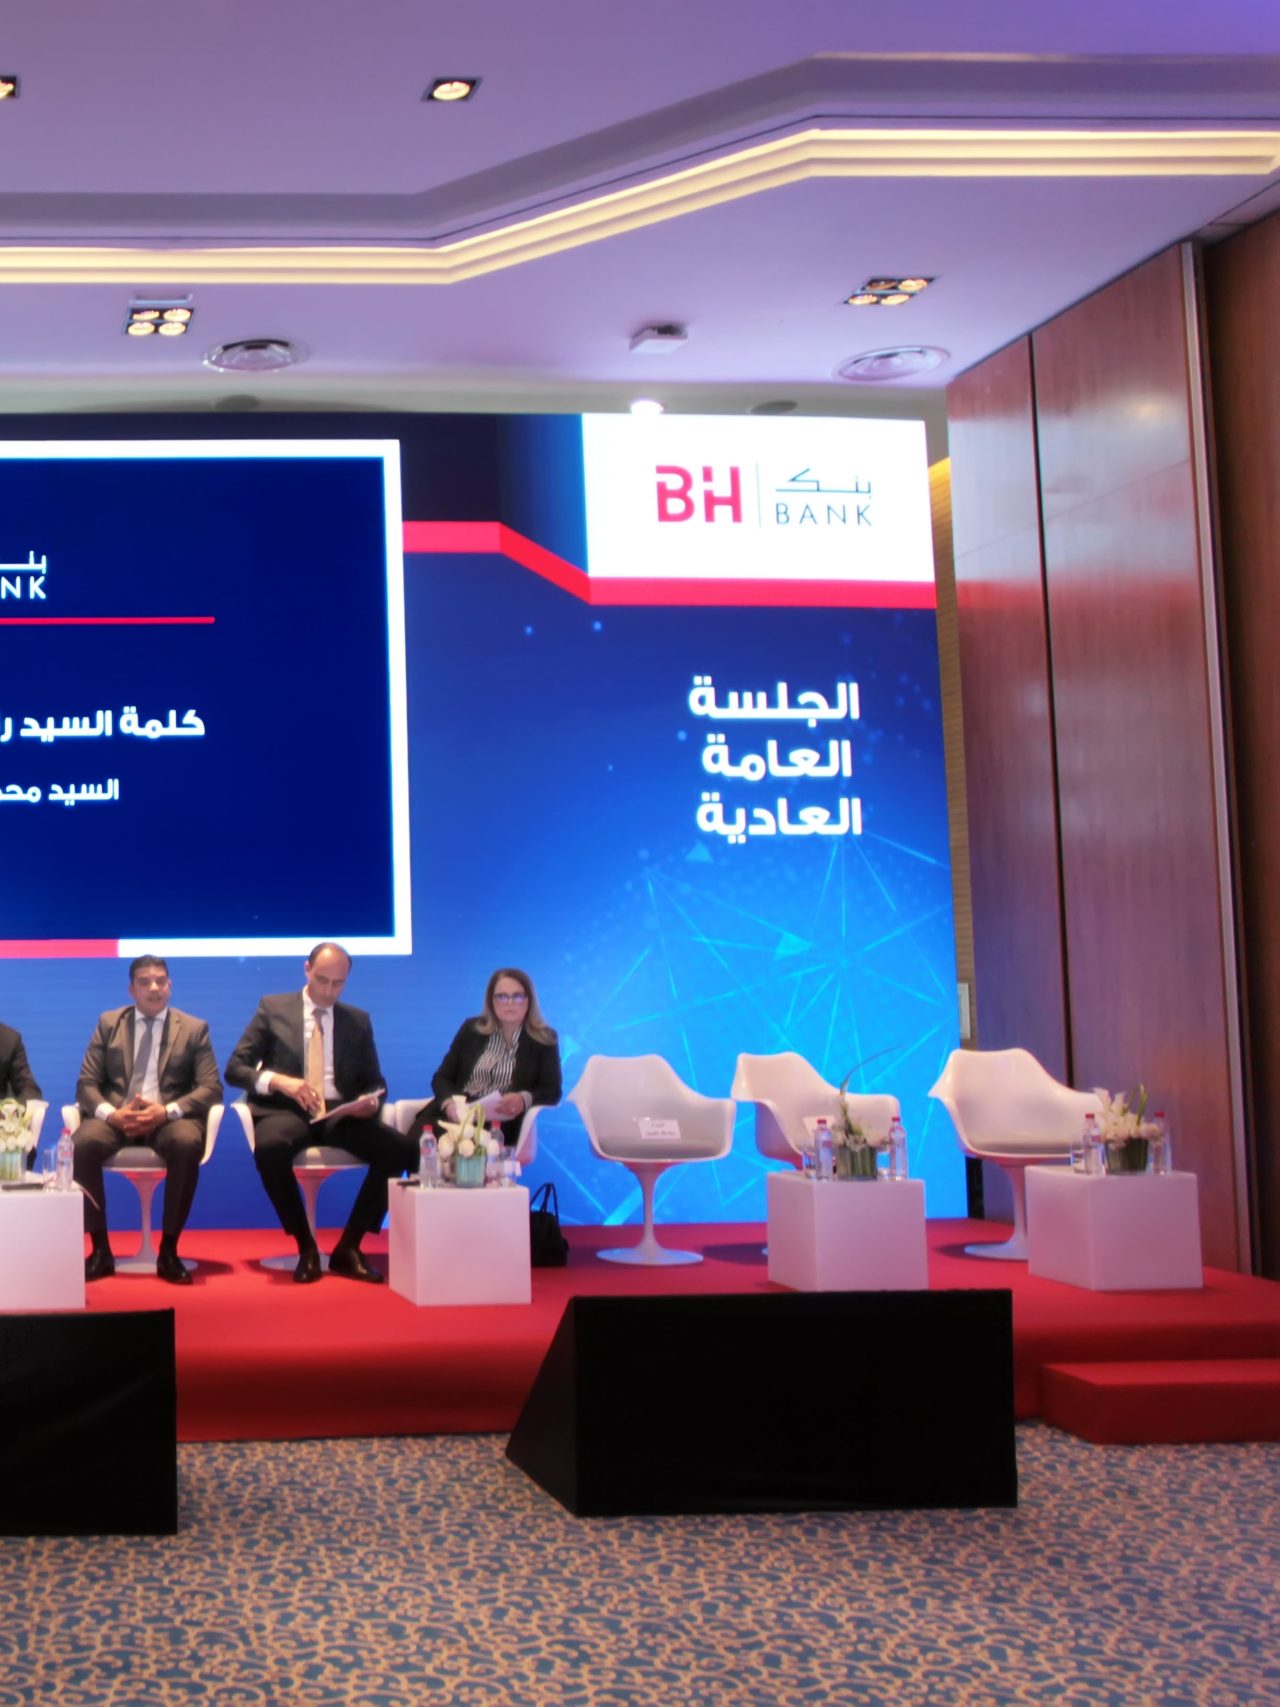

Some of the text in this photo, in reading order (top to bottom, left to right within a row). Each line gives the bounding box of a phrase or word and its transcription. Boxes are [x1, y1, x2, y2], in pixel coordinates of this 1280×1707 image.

[655, 464, 743, 524] BH
[775, 467, 872, 500] بنك
[775, 502, 872, 527] BANK
[688, 675, 861, 728] الجلسة
[20, 710, 114, 743] السيد
[119, 706, 207, 739] كلمة
[702, 733, 853, 782] العامة
[48, 778, 121, 807] السيد
[696, 791, 863, 845] العادية
